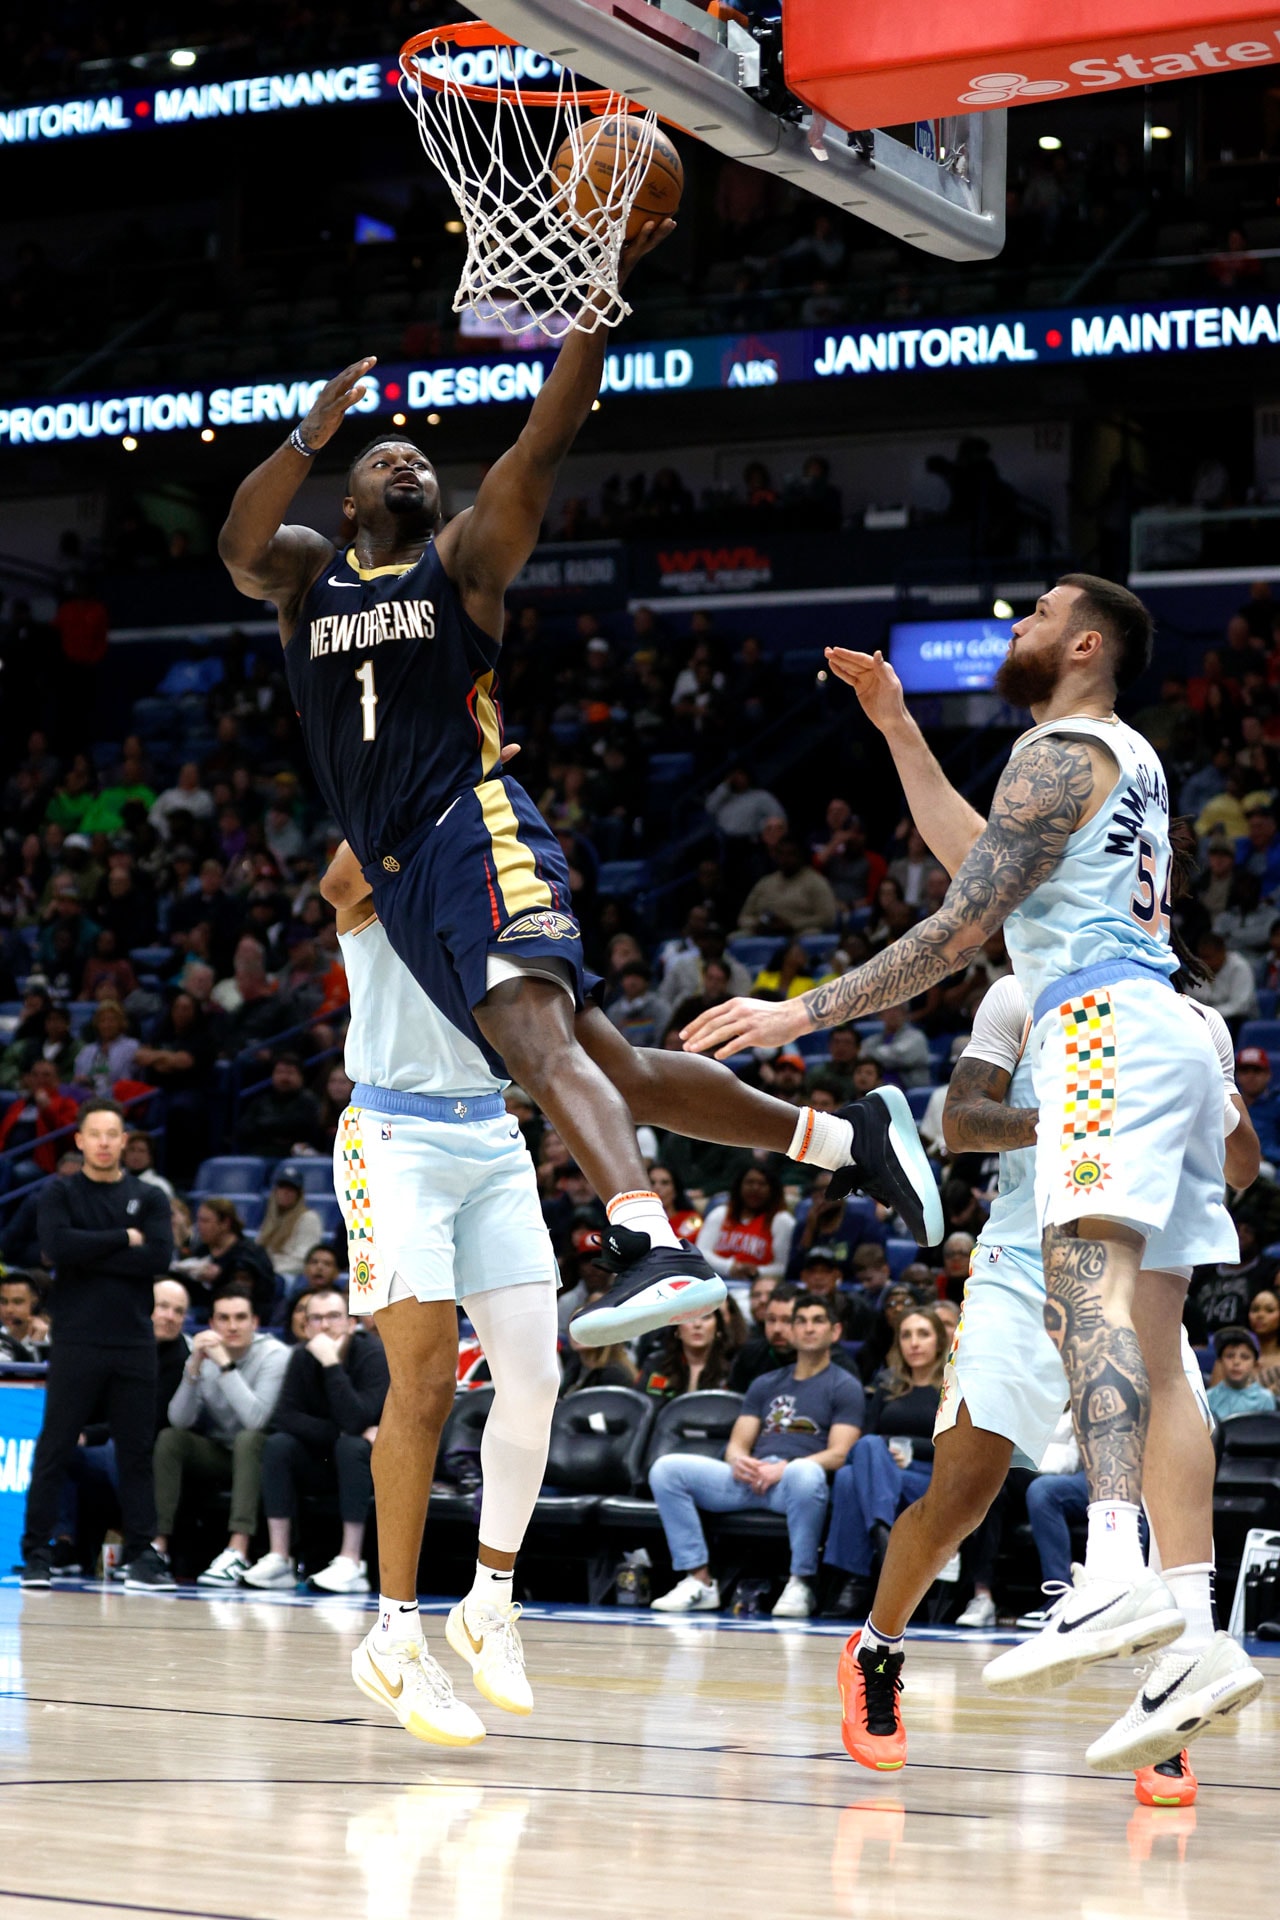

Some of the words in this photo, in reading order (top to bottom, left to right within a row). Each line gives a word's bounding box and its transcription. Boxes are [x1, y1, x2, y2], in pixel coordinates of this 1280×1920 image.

[154, 63, 381, 124] MAINTENANCE
[407, 46, 562, 93] PRODUC
[1069, 40, 1274, 87] State
[208, 375, 380, 426] SERVICS
[408, 360, 544, 408] DESIGN
[728, 359, 778, 388] ABS
[814, 322, 1037, 376] JANITORIAL
[1071, 304, 1280, 357] MAINTENA
[355, 600, 436, 649] OREANS
[354, 660, 379, 742] 1
[1092, 1388, 1116, 1419] 23
[1098, 1474, 1130, 1500] 24
